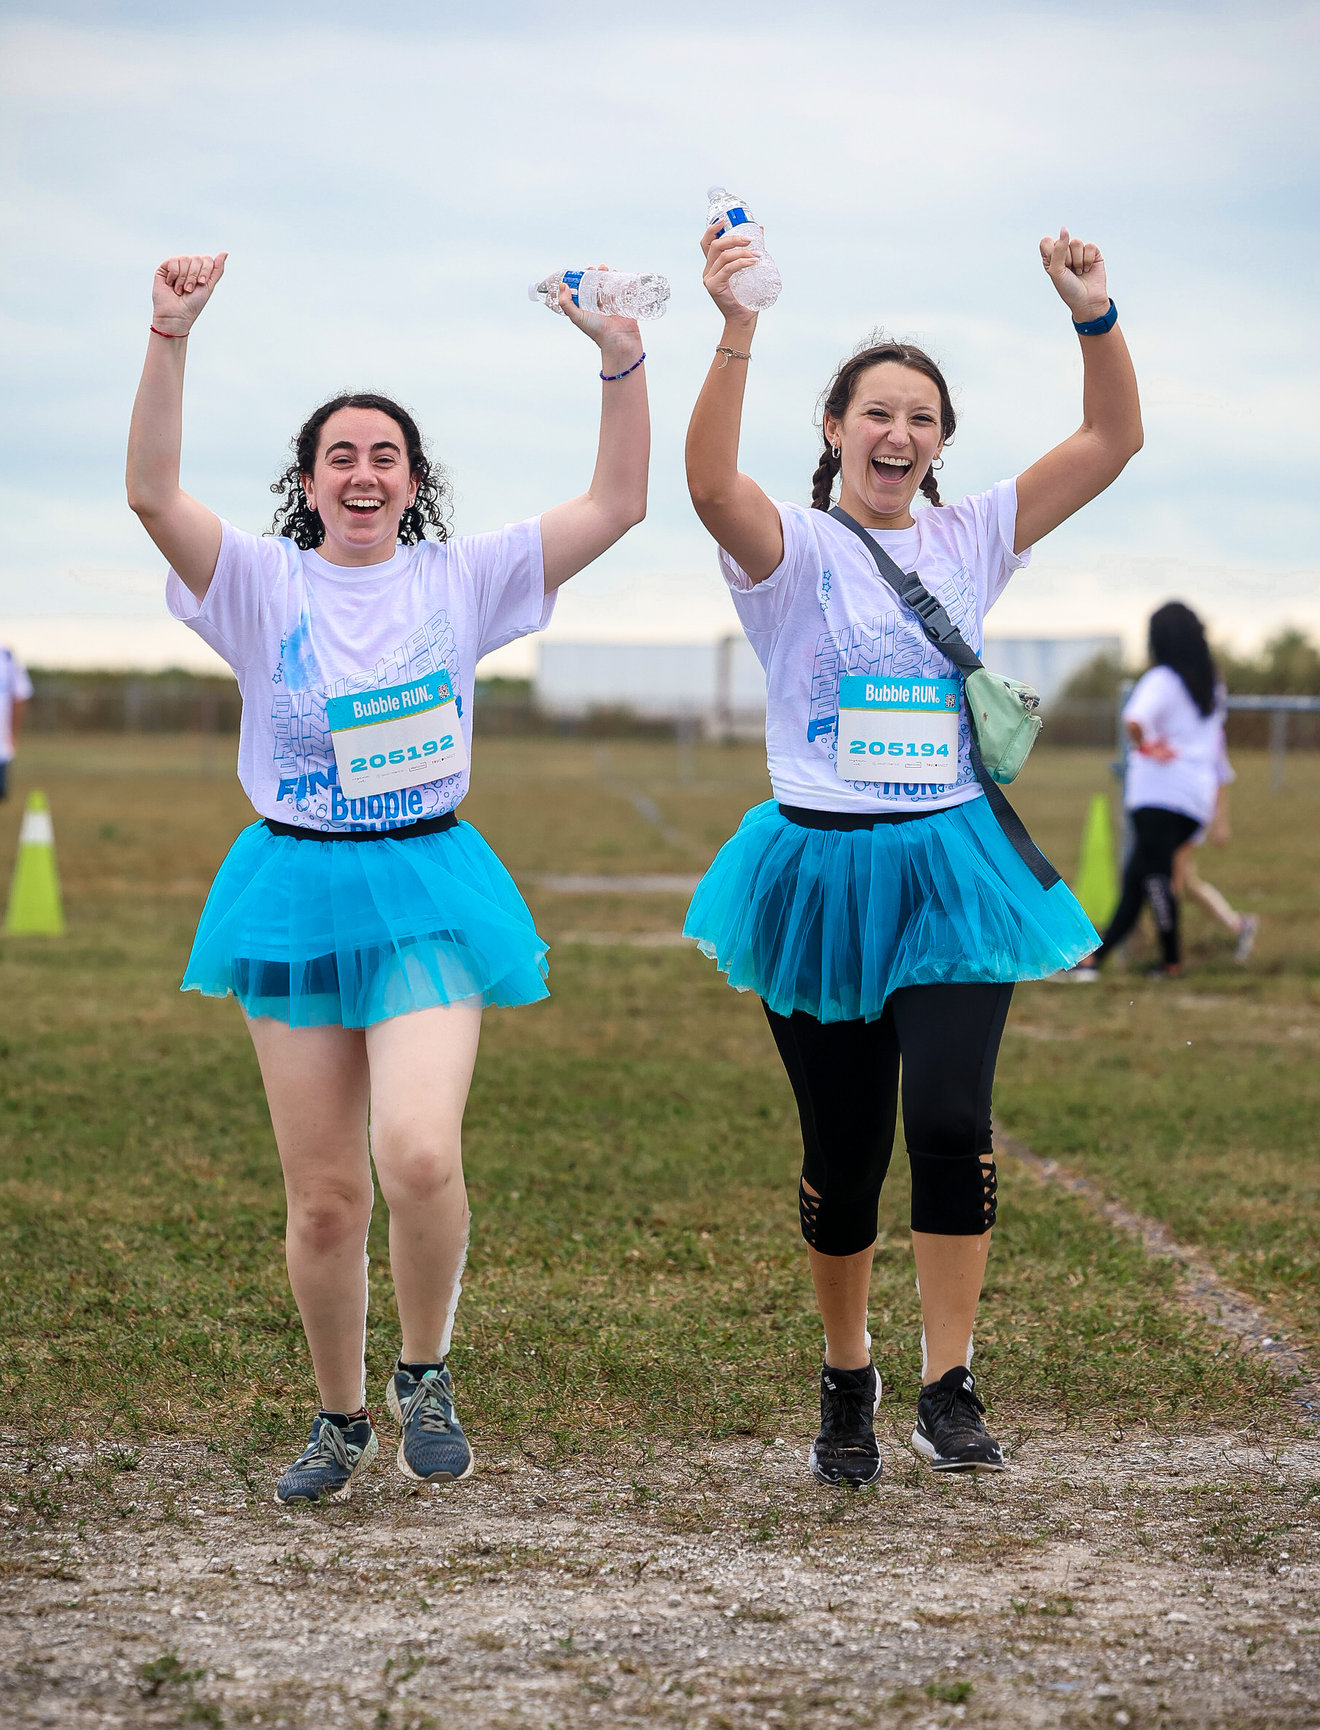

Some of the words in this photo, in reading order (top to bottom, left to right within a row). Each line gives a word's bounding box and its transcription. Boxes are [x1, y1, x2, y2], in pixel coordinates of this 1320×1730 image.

[866, 684, 910, 702] Bubble
[353, 695, 400, 718] Bubble
[350, 735, 455, 773] 205192
[849, 740, 949, 757] 205194
